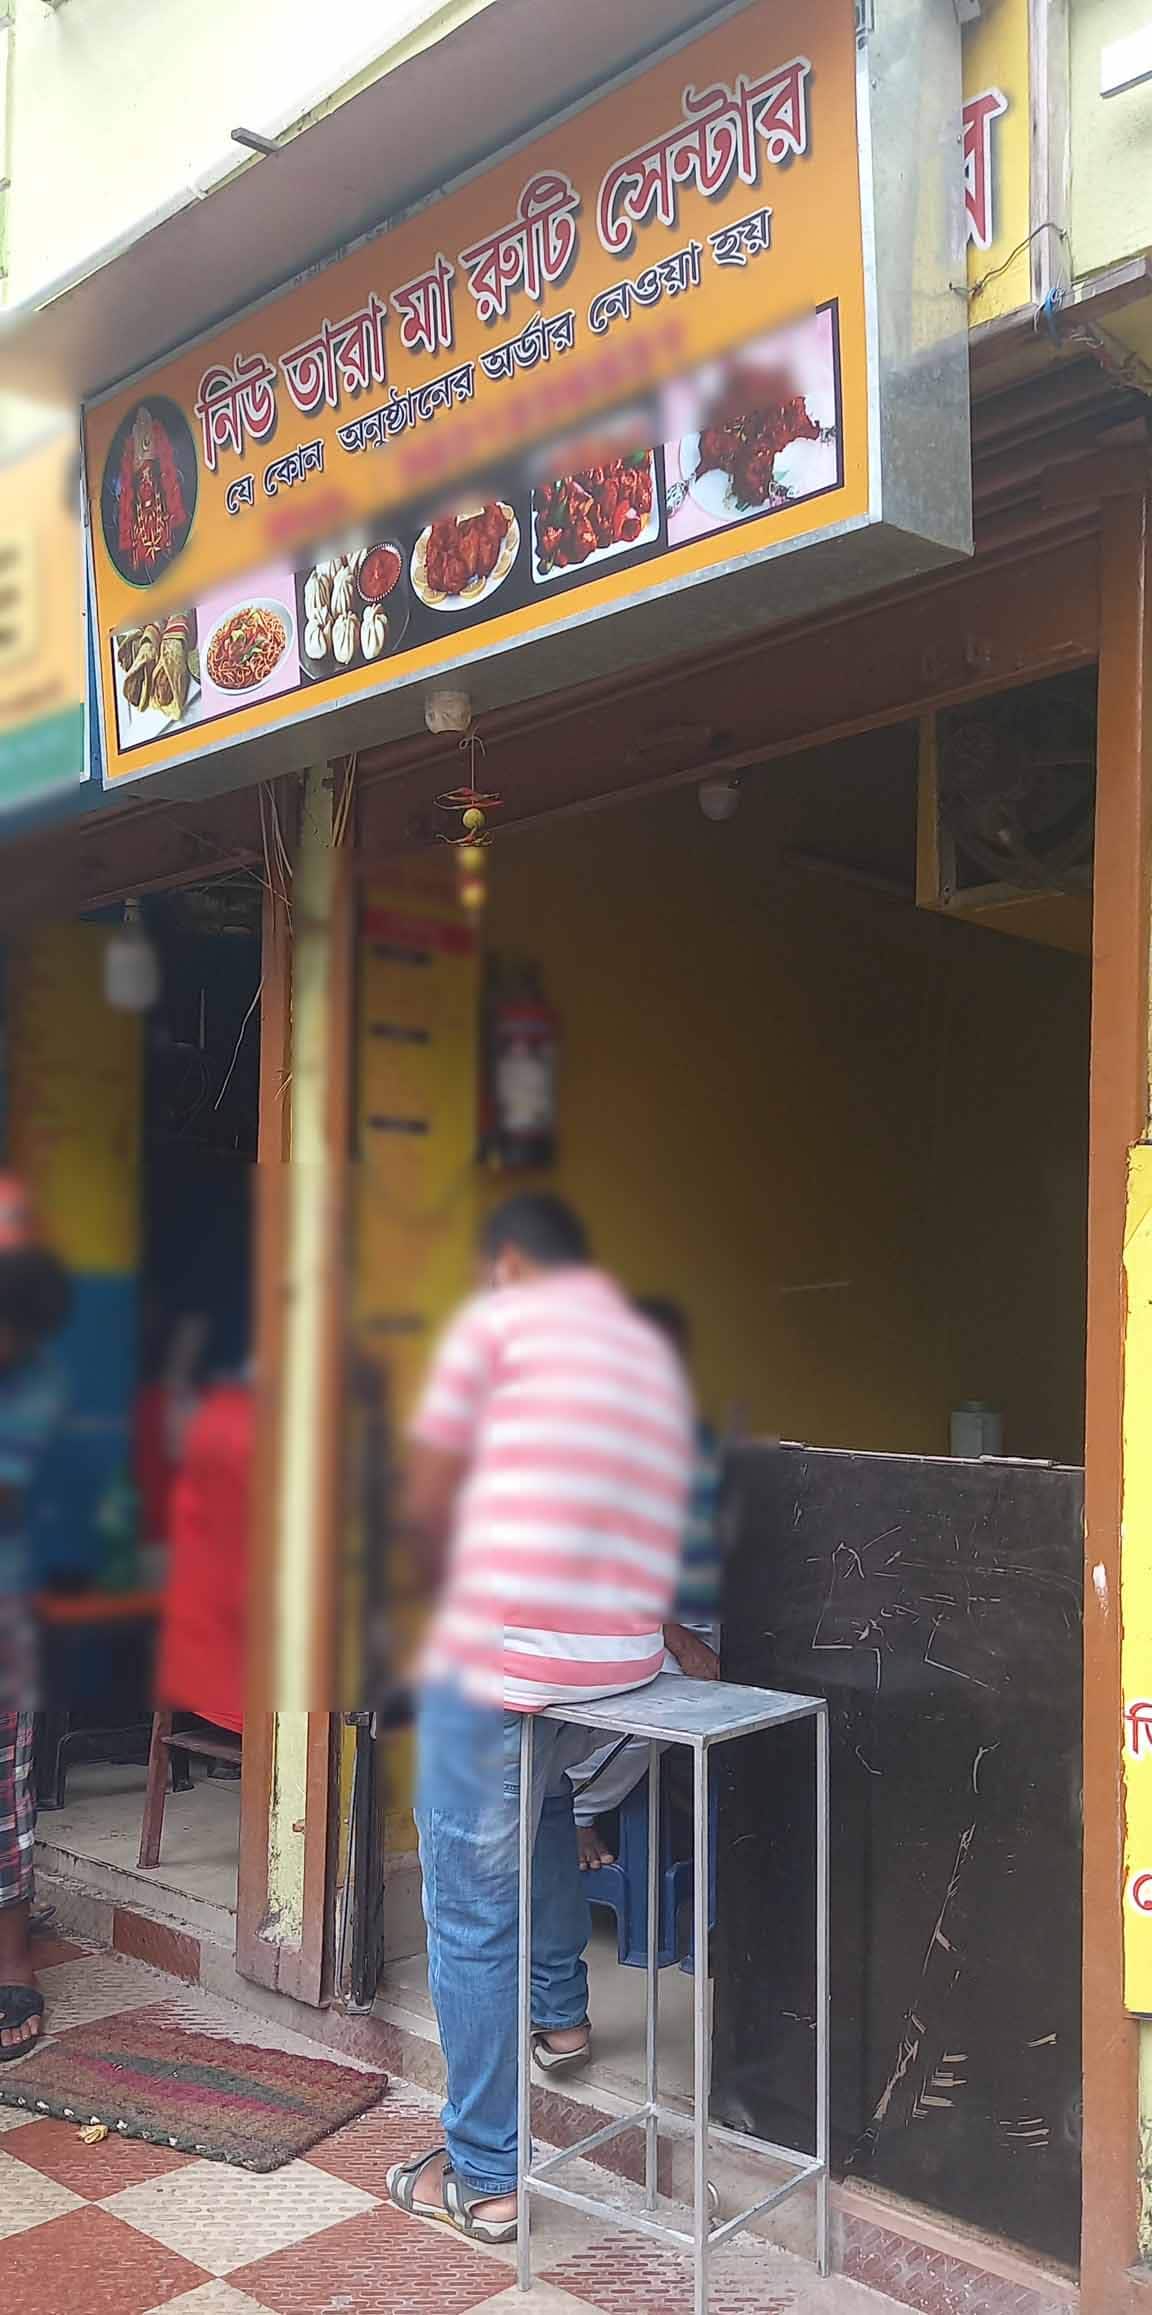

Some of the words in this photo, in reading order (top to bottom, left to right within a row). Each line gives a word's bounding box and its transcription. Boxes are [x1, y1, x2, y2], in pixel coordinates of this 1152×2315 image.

[195, 352, 277, 470] নিউ
[279, 291, 386, 411] তারা
[391, 252, 454, 352] মা
[458, 170, 580, 321] রুটি
[597, 55, 811, 254] সেন্টার
[225, 474, 254, 514] যে
[263, 438, 325, 495] কোন
[336, 360, 476, 452] অনুষ্ঠানের
[479, 310, 576, 379] অর্ডার
[587, 238, 703, 333] নেওয়া
[707, 207, 772, 265] হয়
